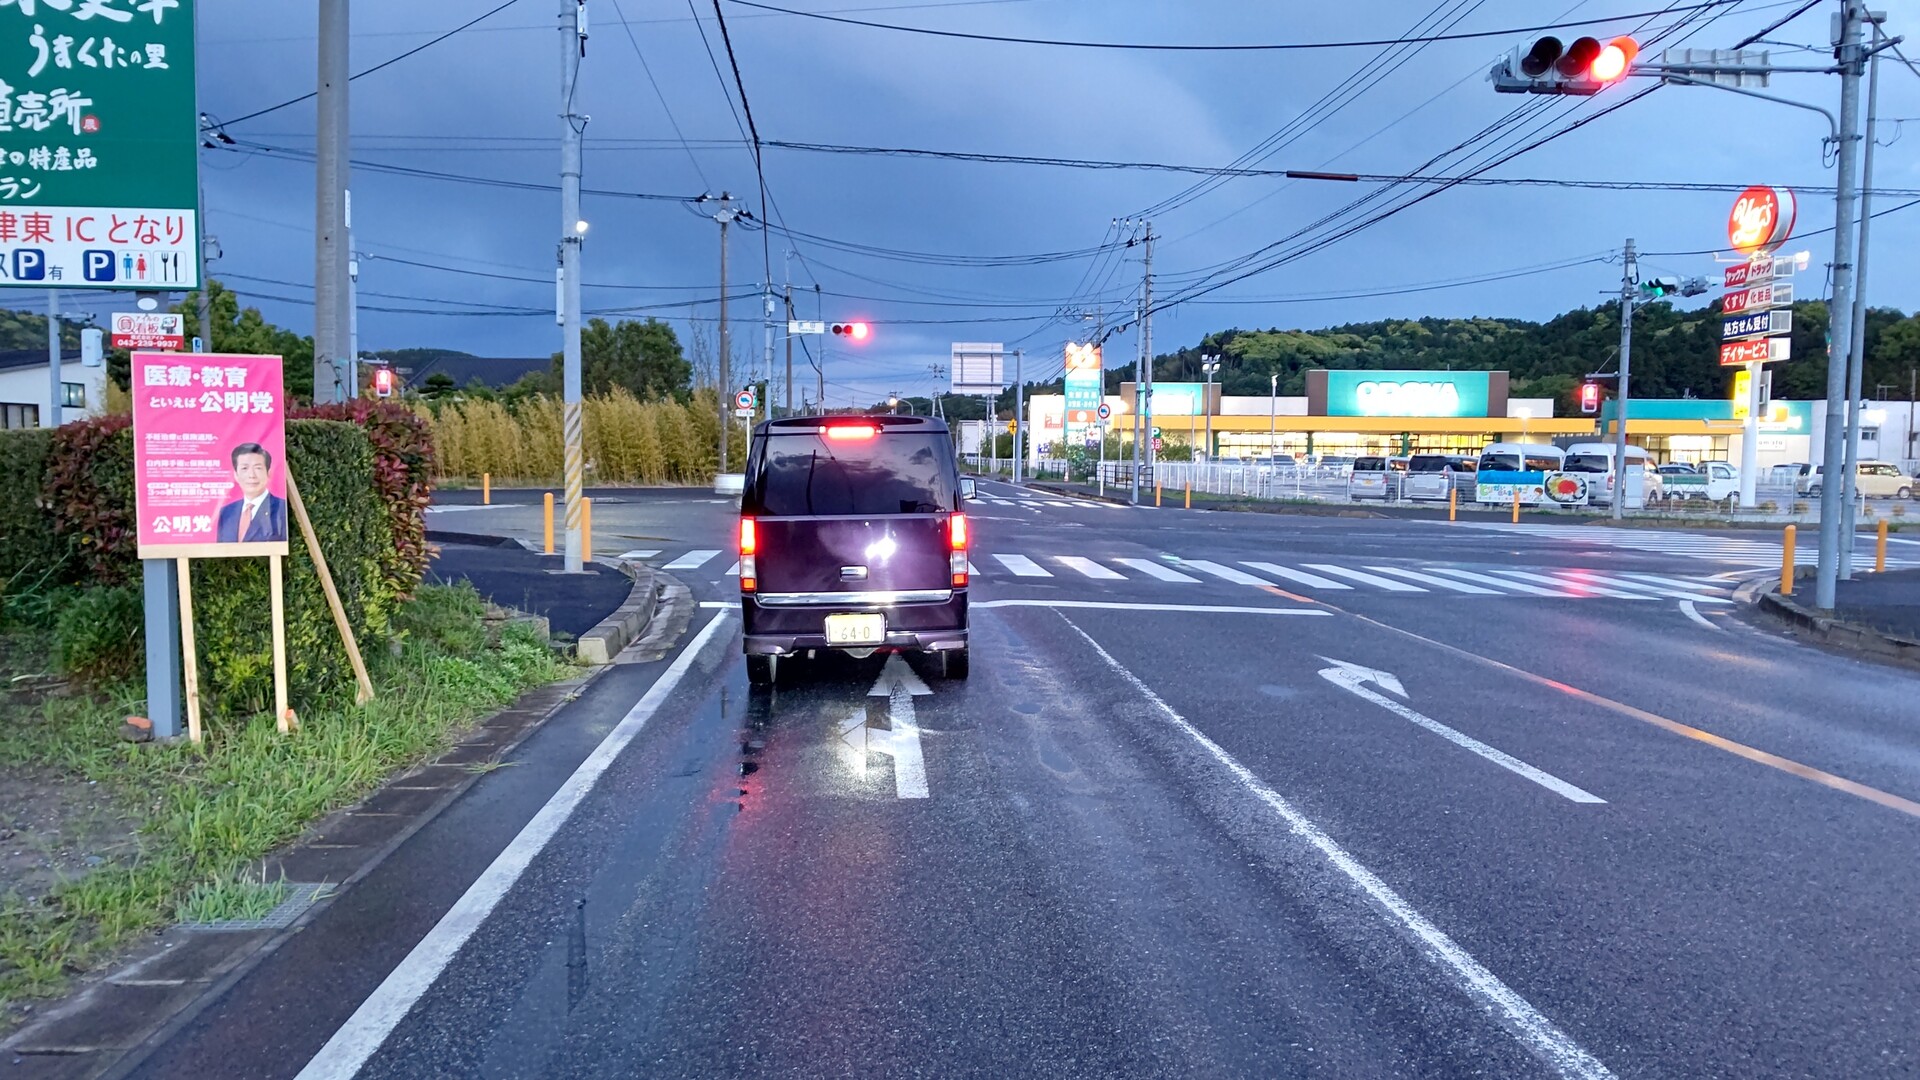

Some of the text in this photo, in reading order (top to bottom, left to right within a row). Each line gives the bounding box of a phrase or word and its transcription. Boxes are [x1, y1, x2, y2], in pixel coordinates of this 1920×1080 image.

[28, 24, 169, 77] うまくたの里
[0, 146, 97, 170] の特産品
[48, 265, 64, 281] 有
[1751, 261, 1773, 278] ドラッグ
[1724, 288, 1772, 310] くすり 化粧品
[1723, 315, 1769, 336] 処方せん受付
[1722, 343, 1768, 362] デイサービス
[143, 365, 247, 388] 医療・教育
[152, 515, 212, 534] 公明党
